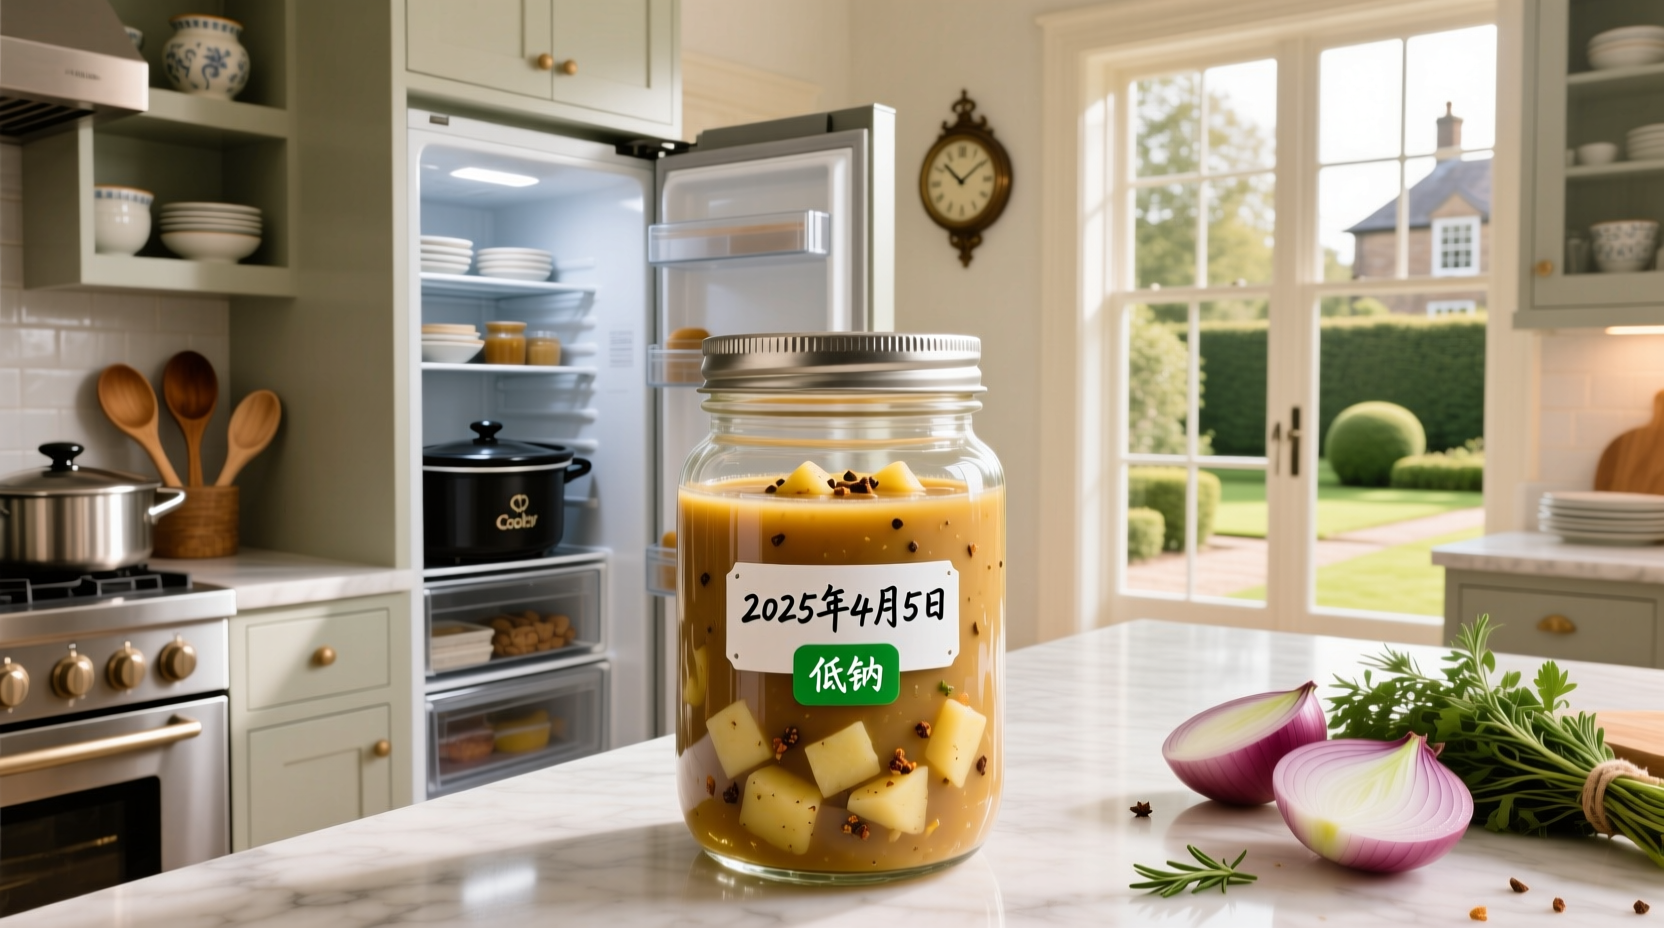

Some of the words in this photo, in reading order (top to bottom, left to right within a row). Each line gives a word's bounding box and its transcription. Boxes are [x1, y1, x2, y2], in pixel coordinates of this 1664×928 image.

[741, 584, 945, 633] 2025年4月5日
[808, 655, 884, 694] 低钠
